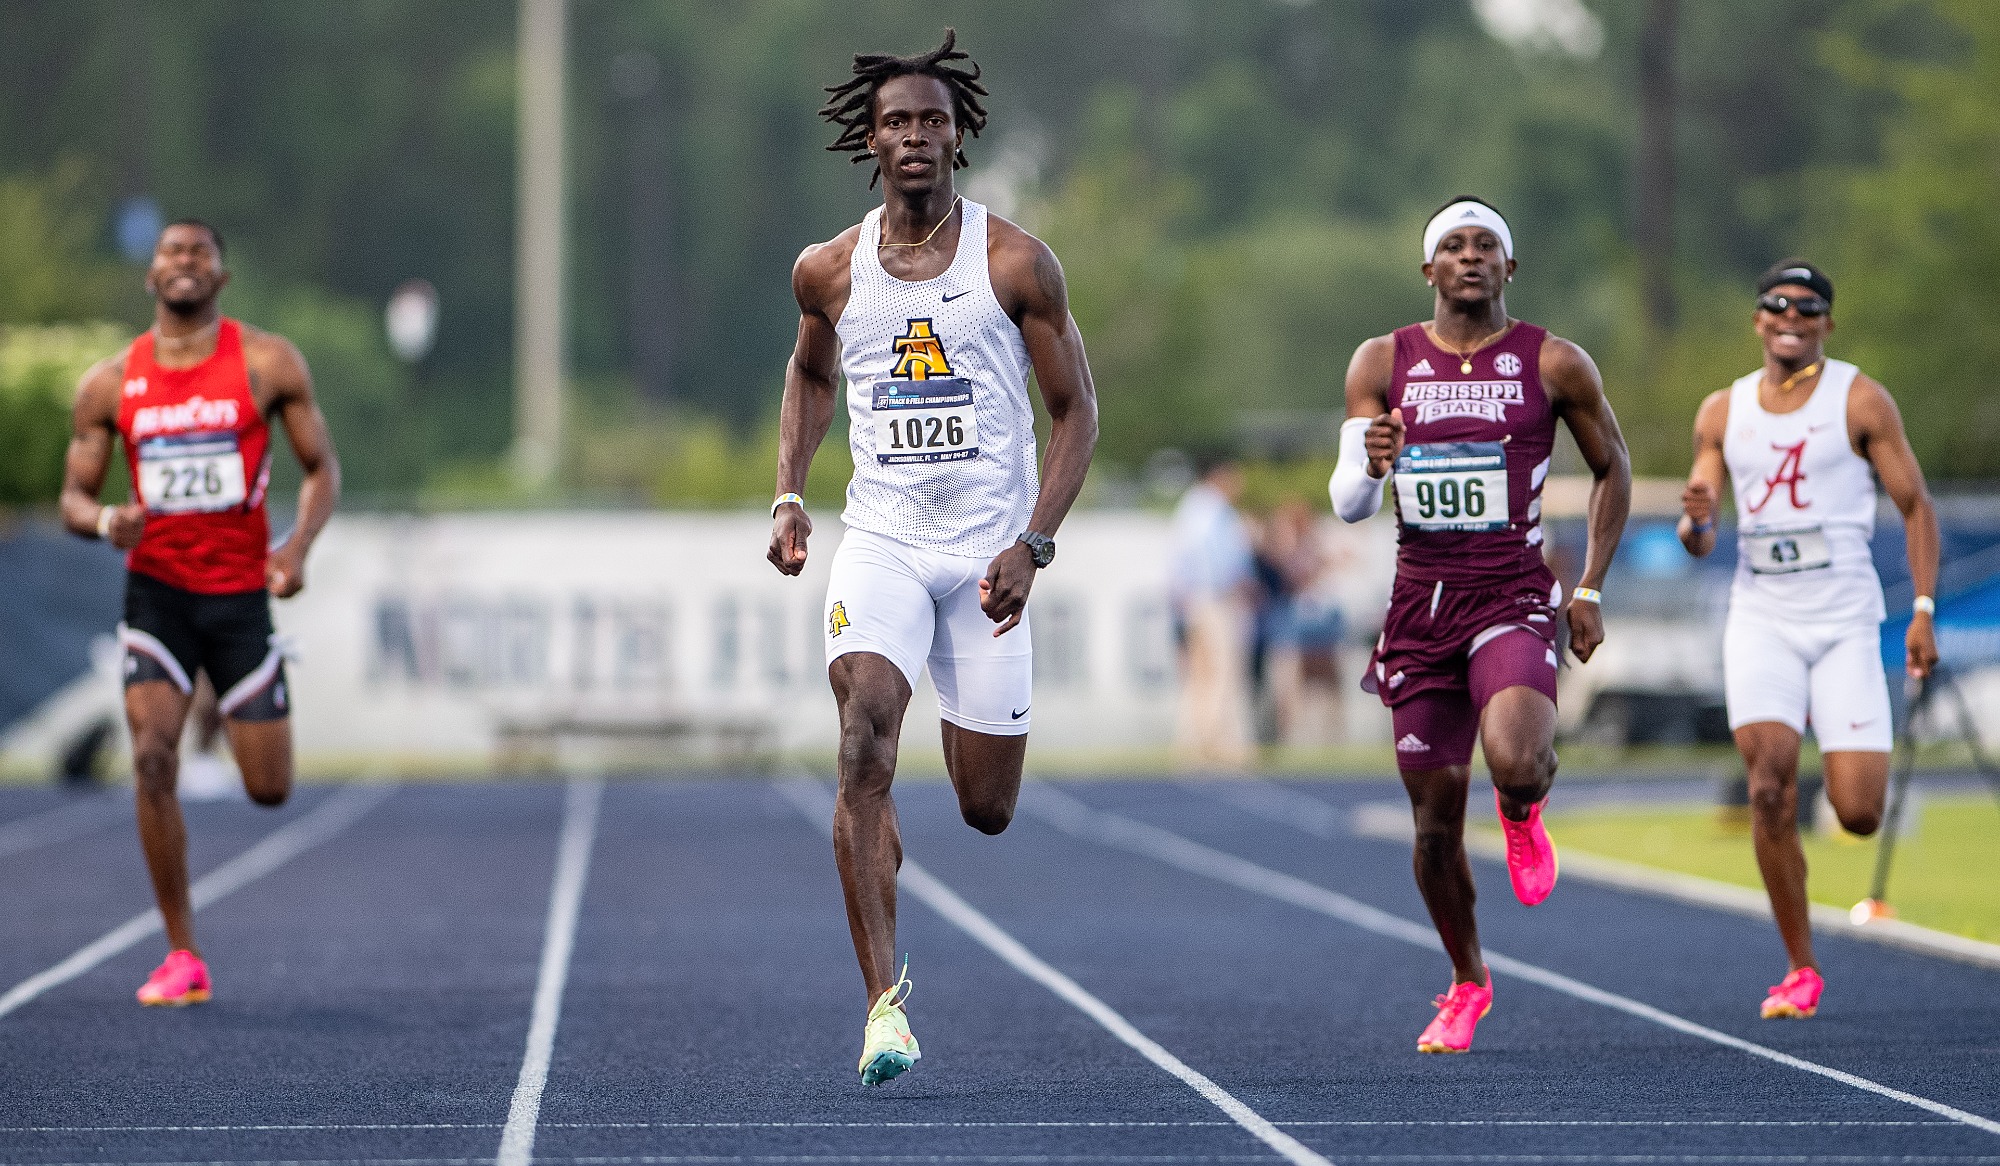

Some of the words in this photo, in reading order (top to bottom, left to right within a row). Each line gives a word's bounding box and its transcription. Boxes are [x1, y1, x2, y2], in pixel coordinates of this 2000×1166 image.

[1495, 353, 1521, 376] SEC
[889, 397, 905, 405] TRACK
[925, 393, 969, 404] CHAMPIONSHIPS
[1401, 383, 1524, 402] MISSISSIPPI
[1432, 402, 1489, 418] STATE
[889, 415, 964, 449] 1026
[160, 462, 222, 499] 226
[1748, 438, 1811, 514] A
[1416, 478, 1485, 519] 996
[1771, 539, 1800, 563] 43
